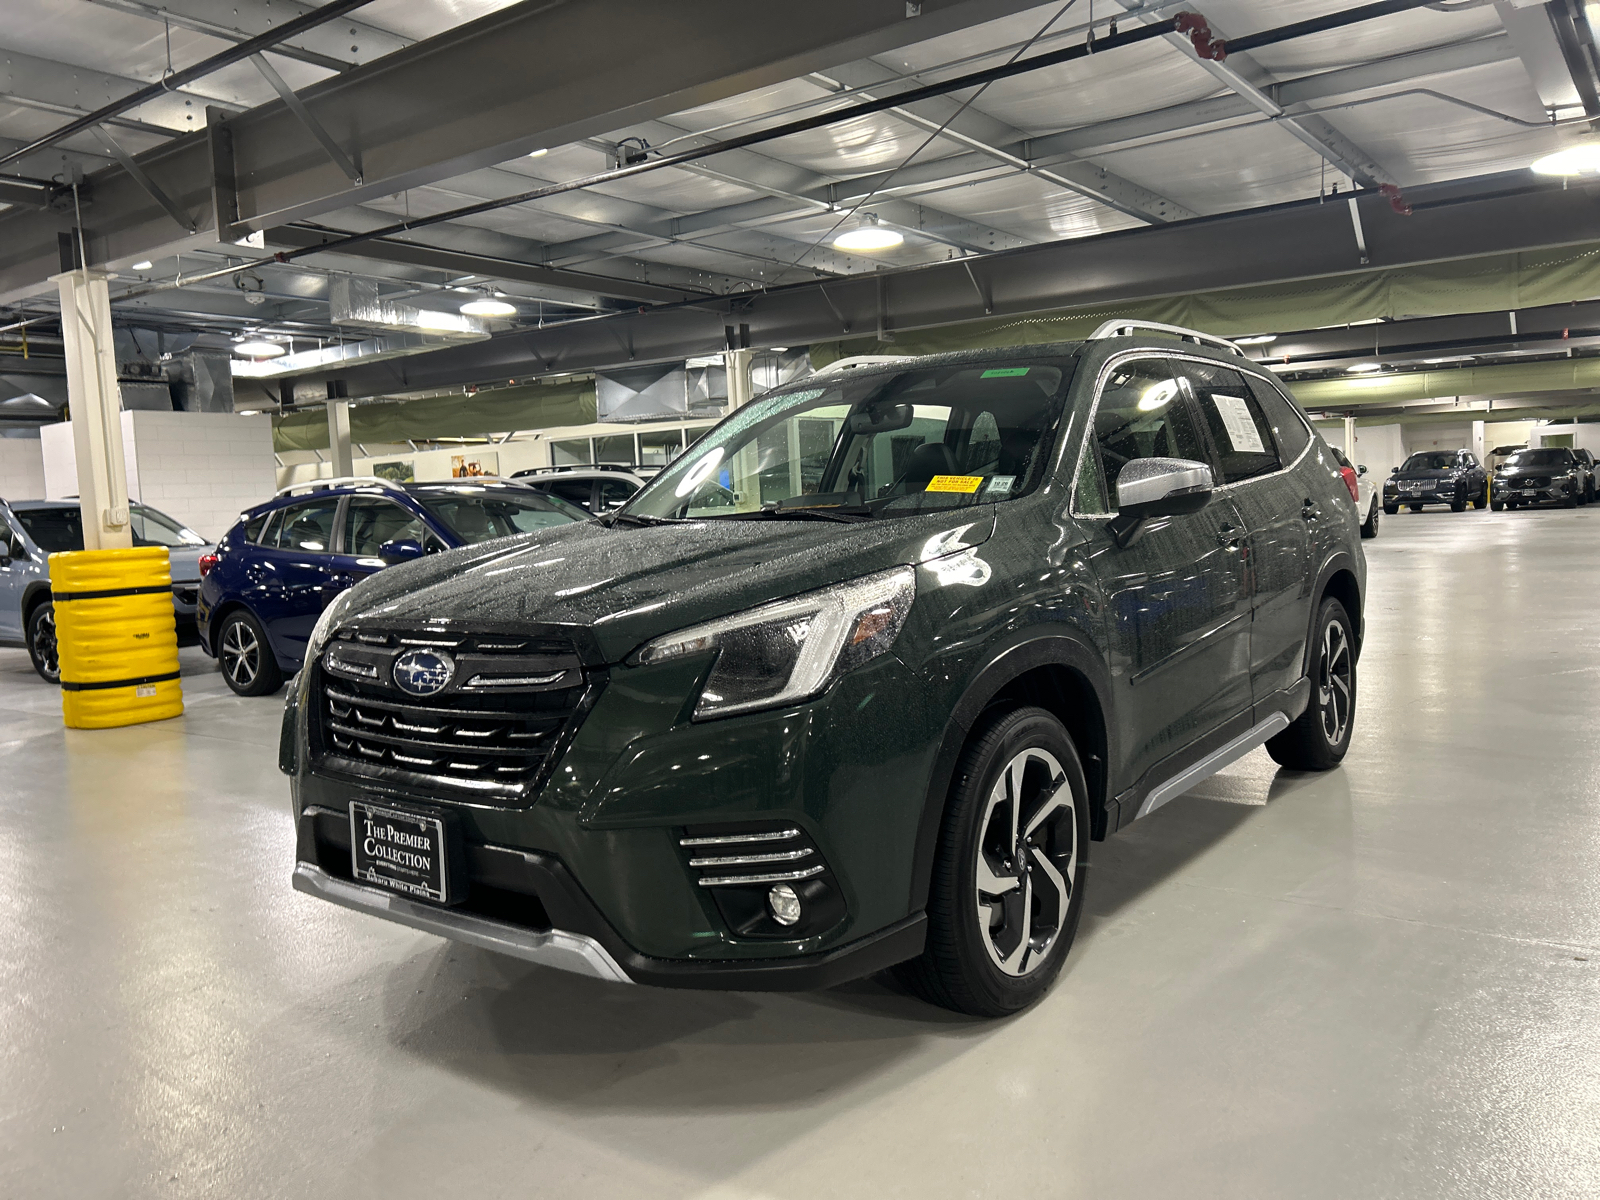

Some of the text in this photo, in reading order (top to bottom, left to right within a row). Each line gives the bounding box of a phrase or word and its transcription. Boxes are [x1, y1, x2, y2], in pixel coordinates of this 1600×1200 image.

[364, 819, 431, 851] THE PREMIER
[364, 837, 431, 871] COLLECTION
